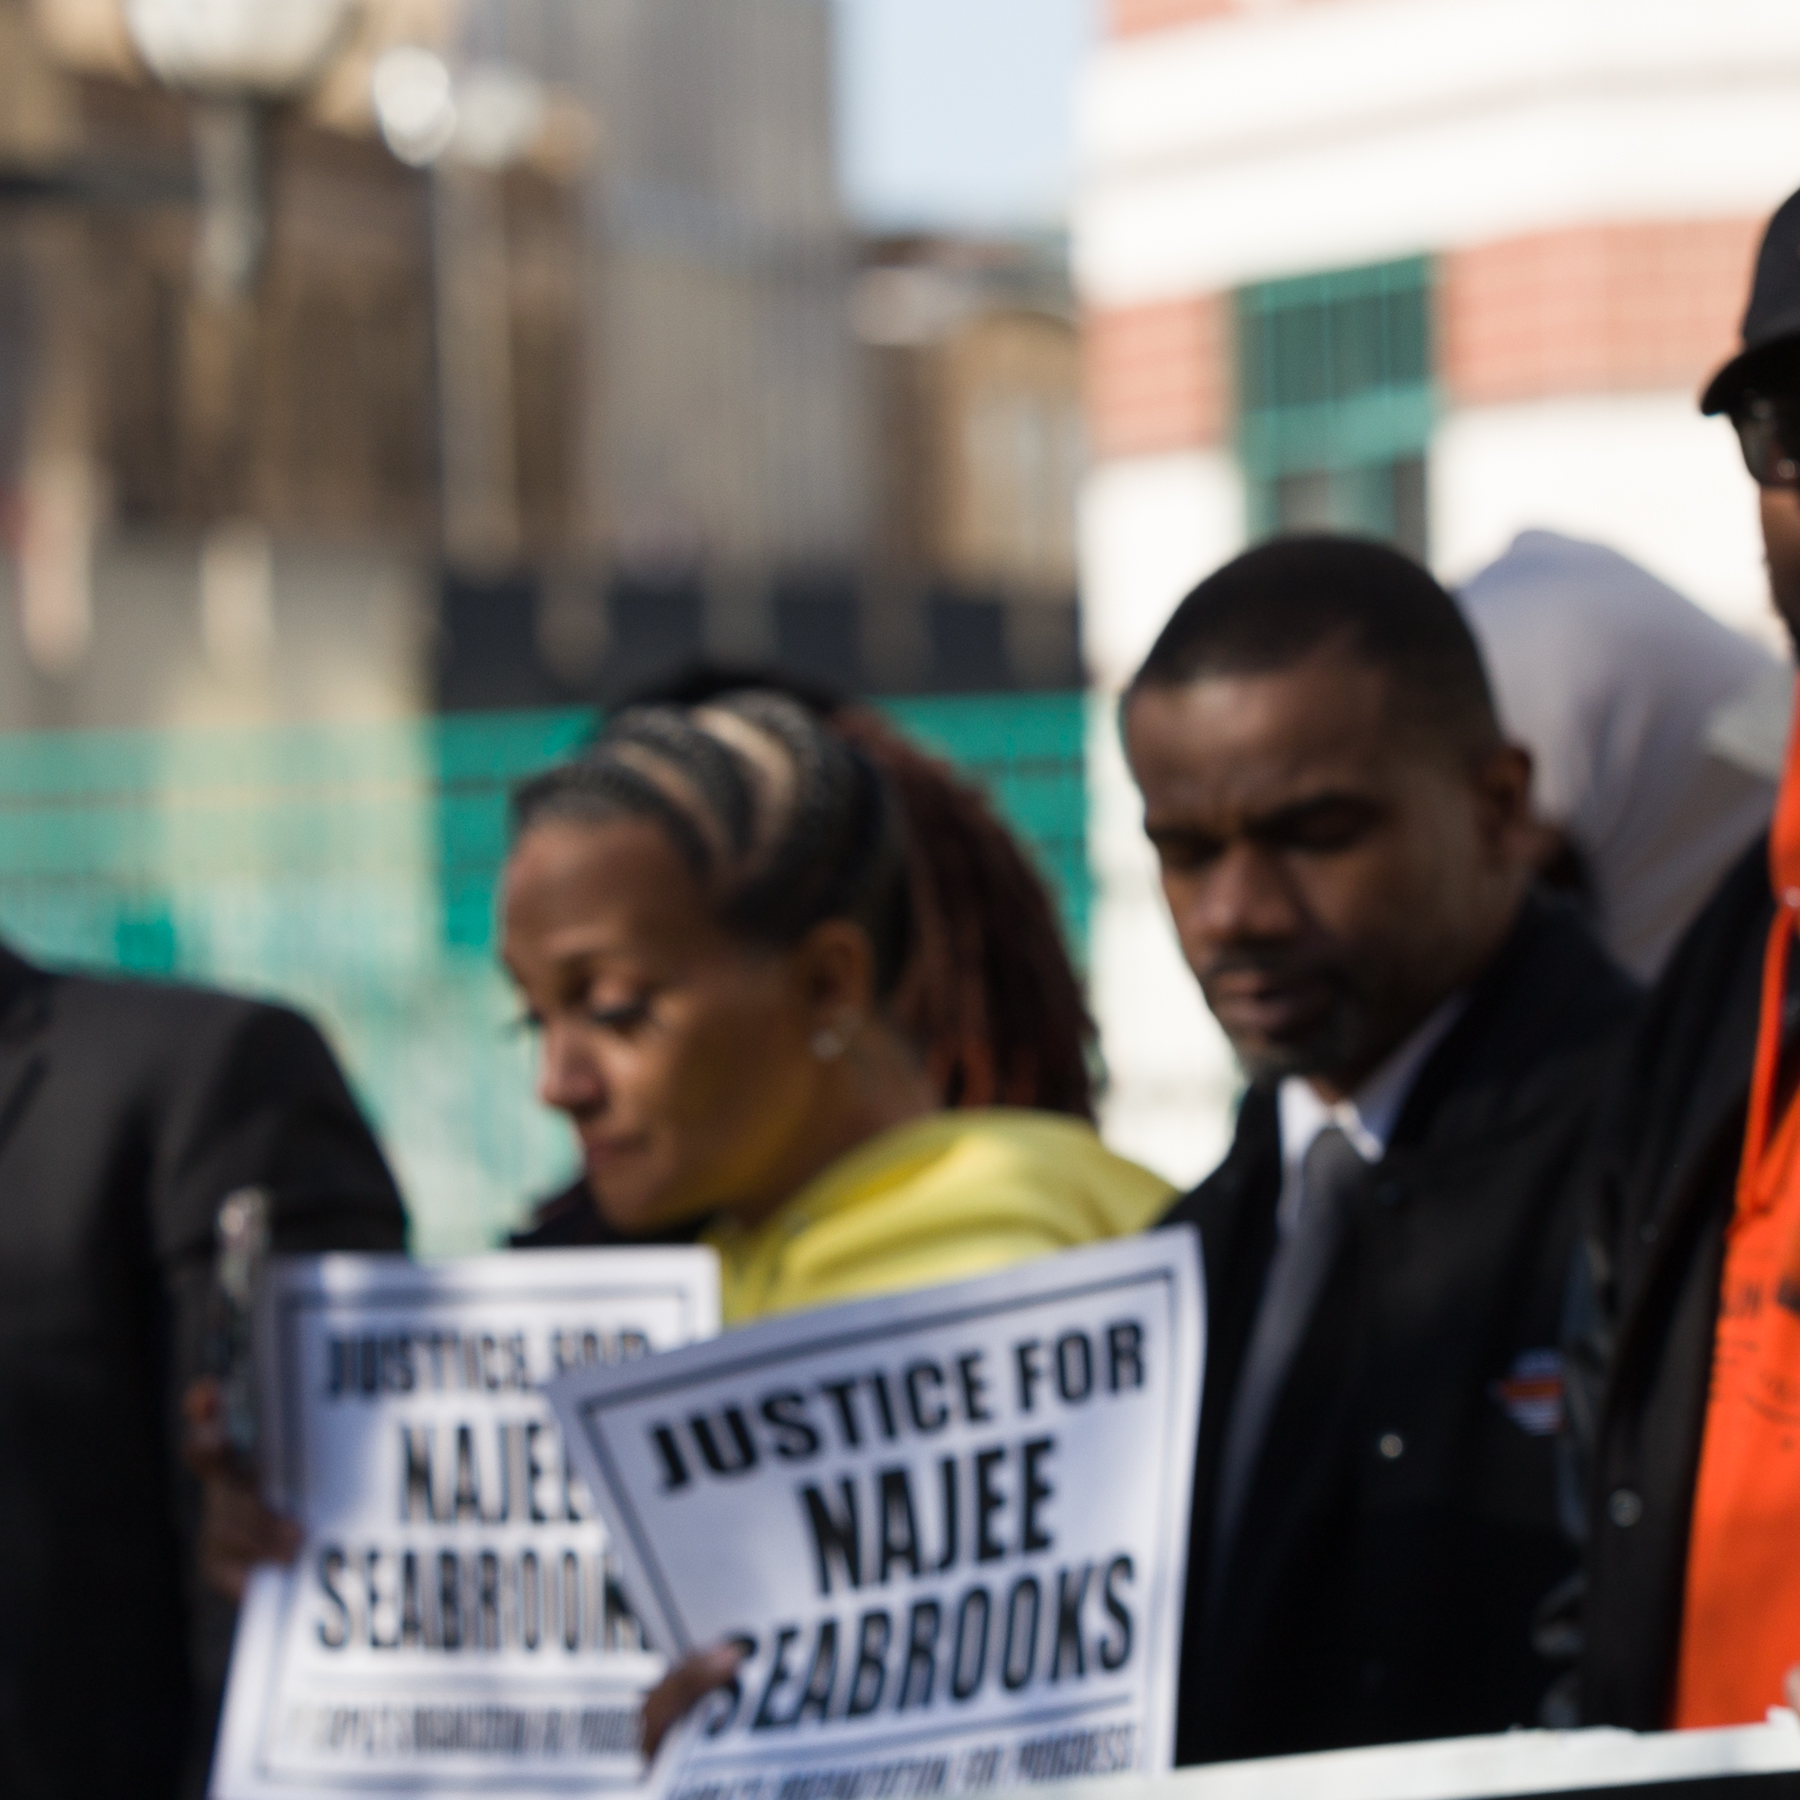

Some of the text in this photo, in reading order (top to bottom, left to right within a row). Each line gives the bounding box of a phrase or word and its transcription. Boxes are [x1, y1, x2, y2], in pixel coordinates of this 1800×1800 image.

[649, 1320, 1145, 1491] JUSTICE FOR
[800, 1433, 1056, 1598] NAJEE
[704, 1554, 1138, 1741] SEABROOKS
